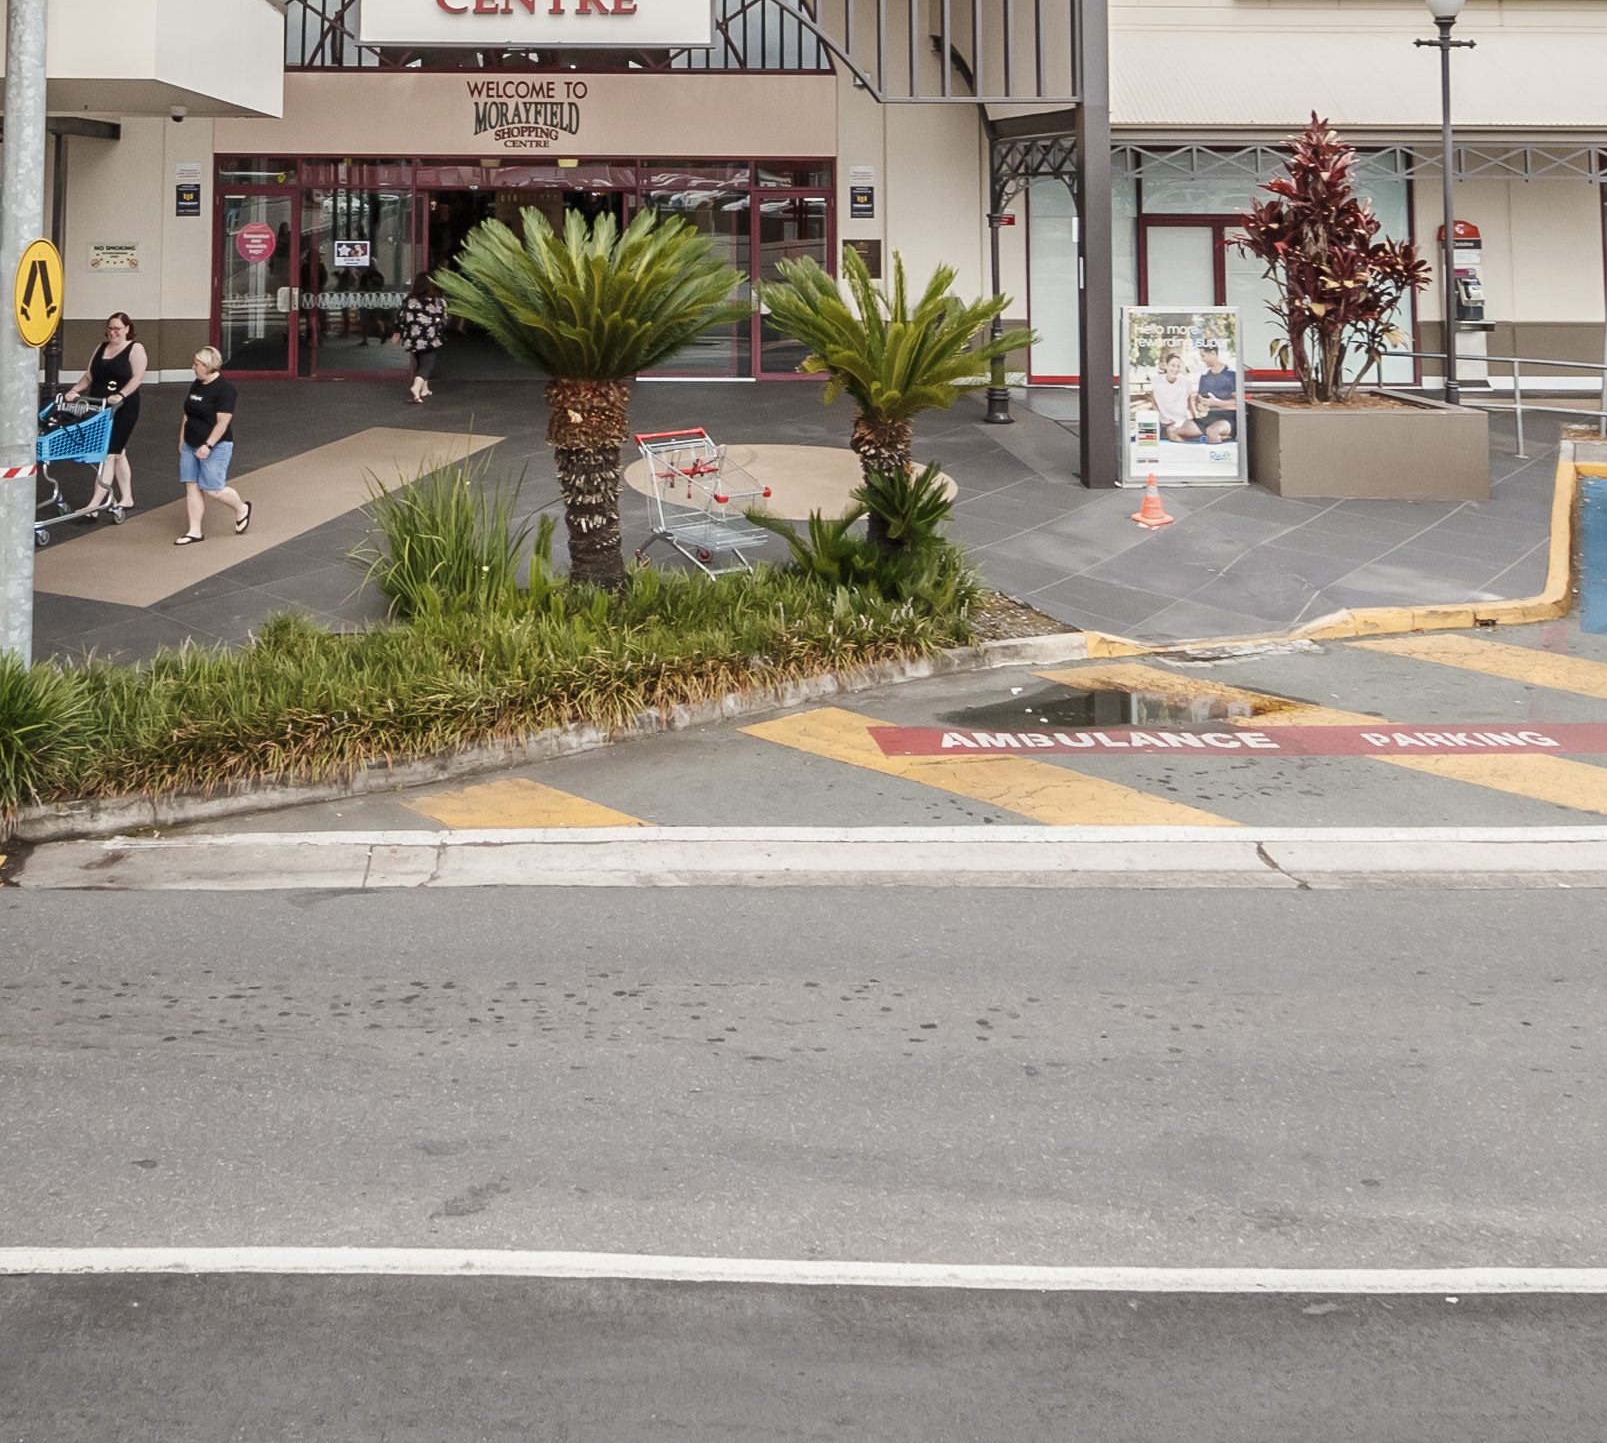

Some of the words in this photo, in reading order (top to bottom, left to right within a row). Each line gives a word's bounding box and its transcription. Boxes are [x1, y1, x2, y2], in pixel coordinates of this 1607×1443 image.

[466, 80, 556, 99] WELCOME
[563, 81, 588, 99] TO
[473, 100, 580, 136] MORAYFIELD
[494, 125, 559, 142] SHOPPING
[503, 139, 550, 148] CENTRE
[1167, 325, 1200, 335] more
[941, 730, 1281, 750] AMBULANCE
[1360, 730, 1560, 748] PARKING
